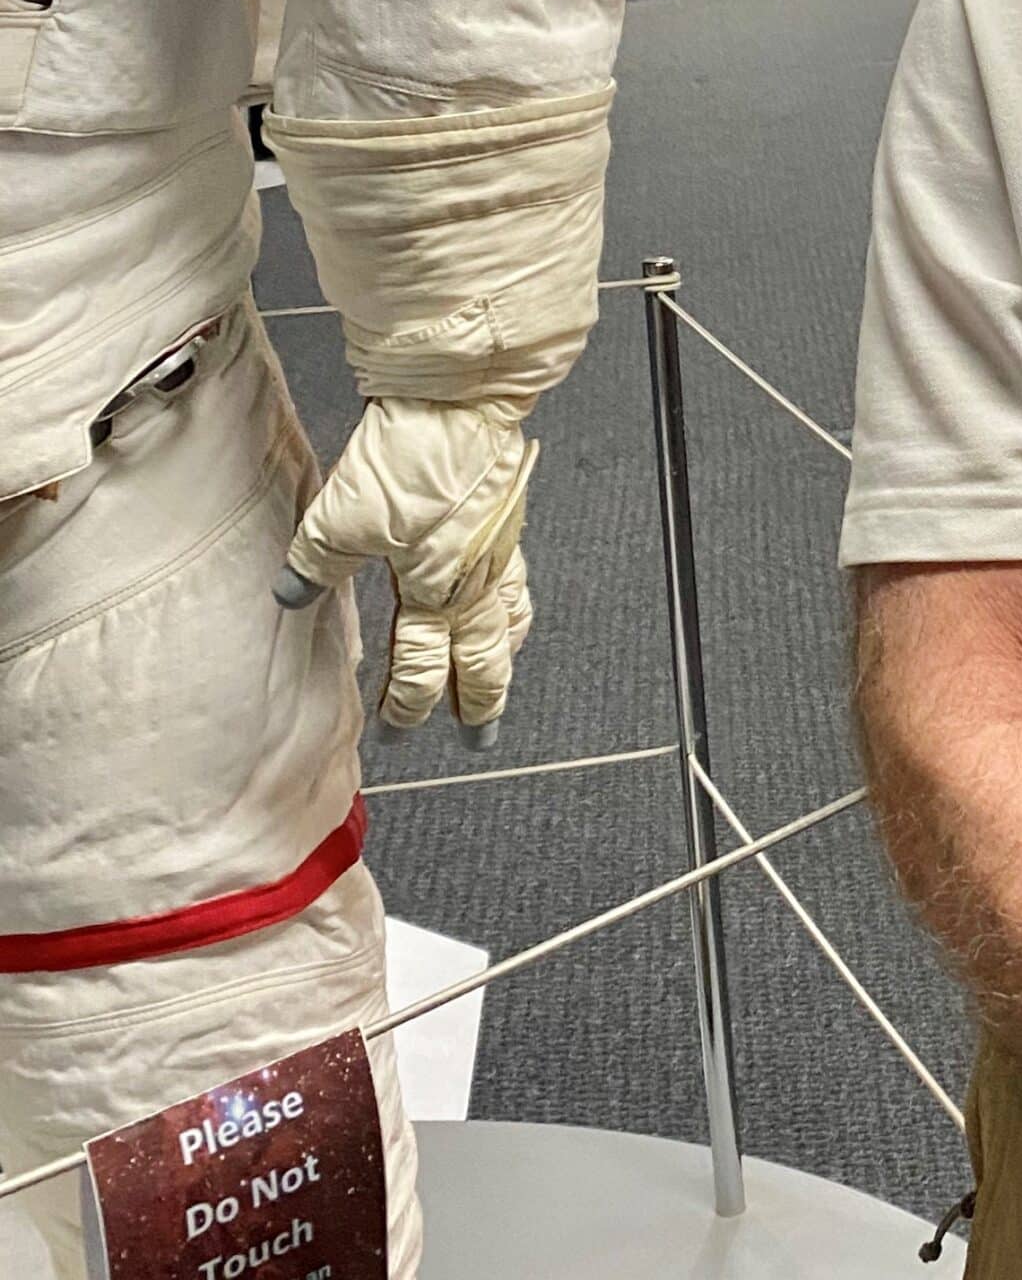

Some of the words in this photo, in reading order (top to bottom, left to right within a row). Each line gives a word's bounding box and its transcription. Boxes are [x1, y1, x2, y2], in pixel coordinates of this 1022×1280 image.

[179, 1088, 305, 1166] Please
[184, 1198, 240, 1242] Do
[250, 1155, 321, 1209] Not
[197, 1217, 315, 1280] Touch
